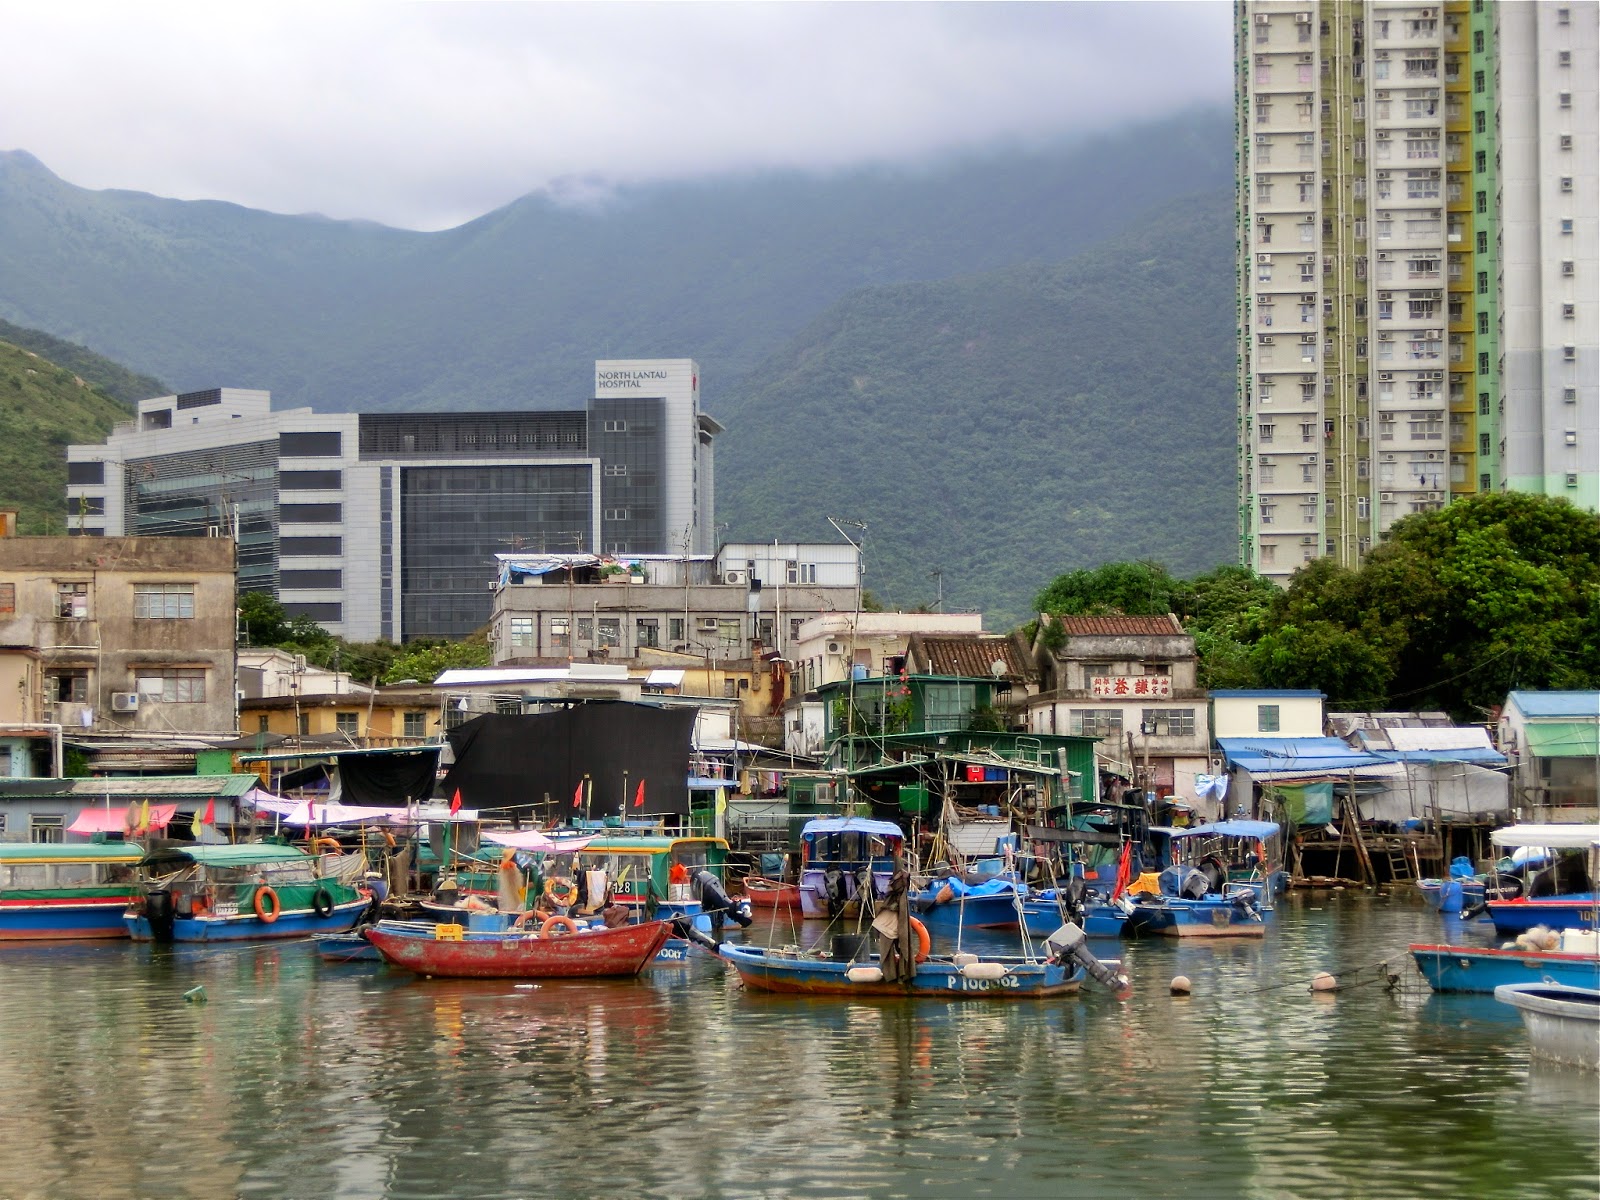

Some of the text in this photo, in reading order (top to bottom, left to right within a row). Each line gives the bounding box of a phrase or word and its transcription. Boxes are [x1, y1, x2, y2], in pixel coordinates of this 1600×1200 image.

[598, 371, 667, 380] NORTH LANTAU
[598, 380, 641, 389] HOSPITAL
[947, 975, 957, 989] P
